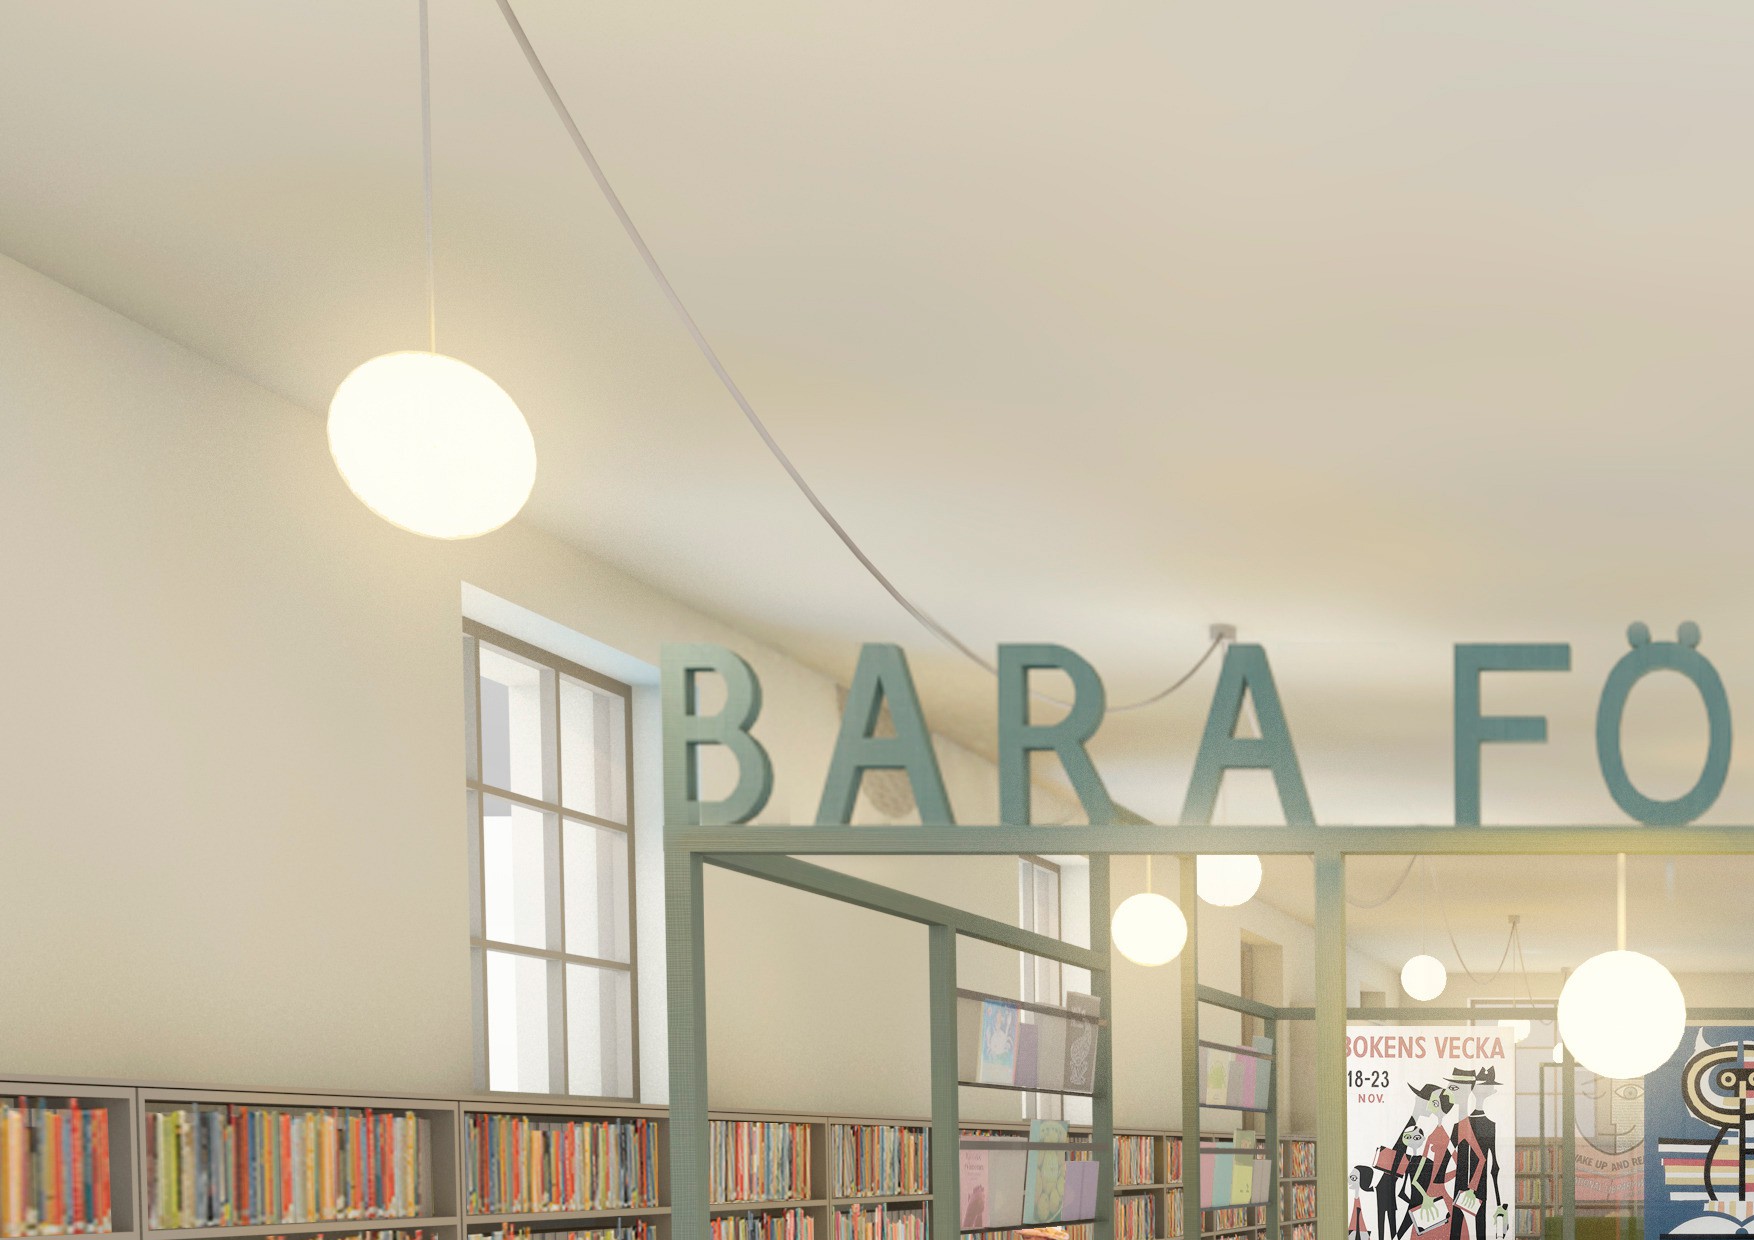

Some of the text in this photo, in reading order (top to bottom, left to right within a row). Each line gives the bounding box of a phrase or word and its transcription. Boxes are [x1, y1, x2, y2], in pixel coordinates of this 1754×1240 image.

[660, 642, 1317, 827] BARA
[1434, 1036, 1506, 1060] VECKA
[1347, 1070, 1390, 1089] 18-23
[1357, 1093, 1385, 1104] NOV.
[1595, 1160, 1608, 1170] UP
[1611, 1159, 1630, 1172] AND
[1631, 1155, 1644, 1167] RE
